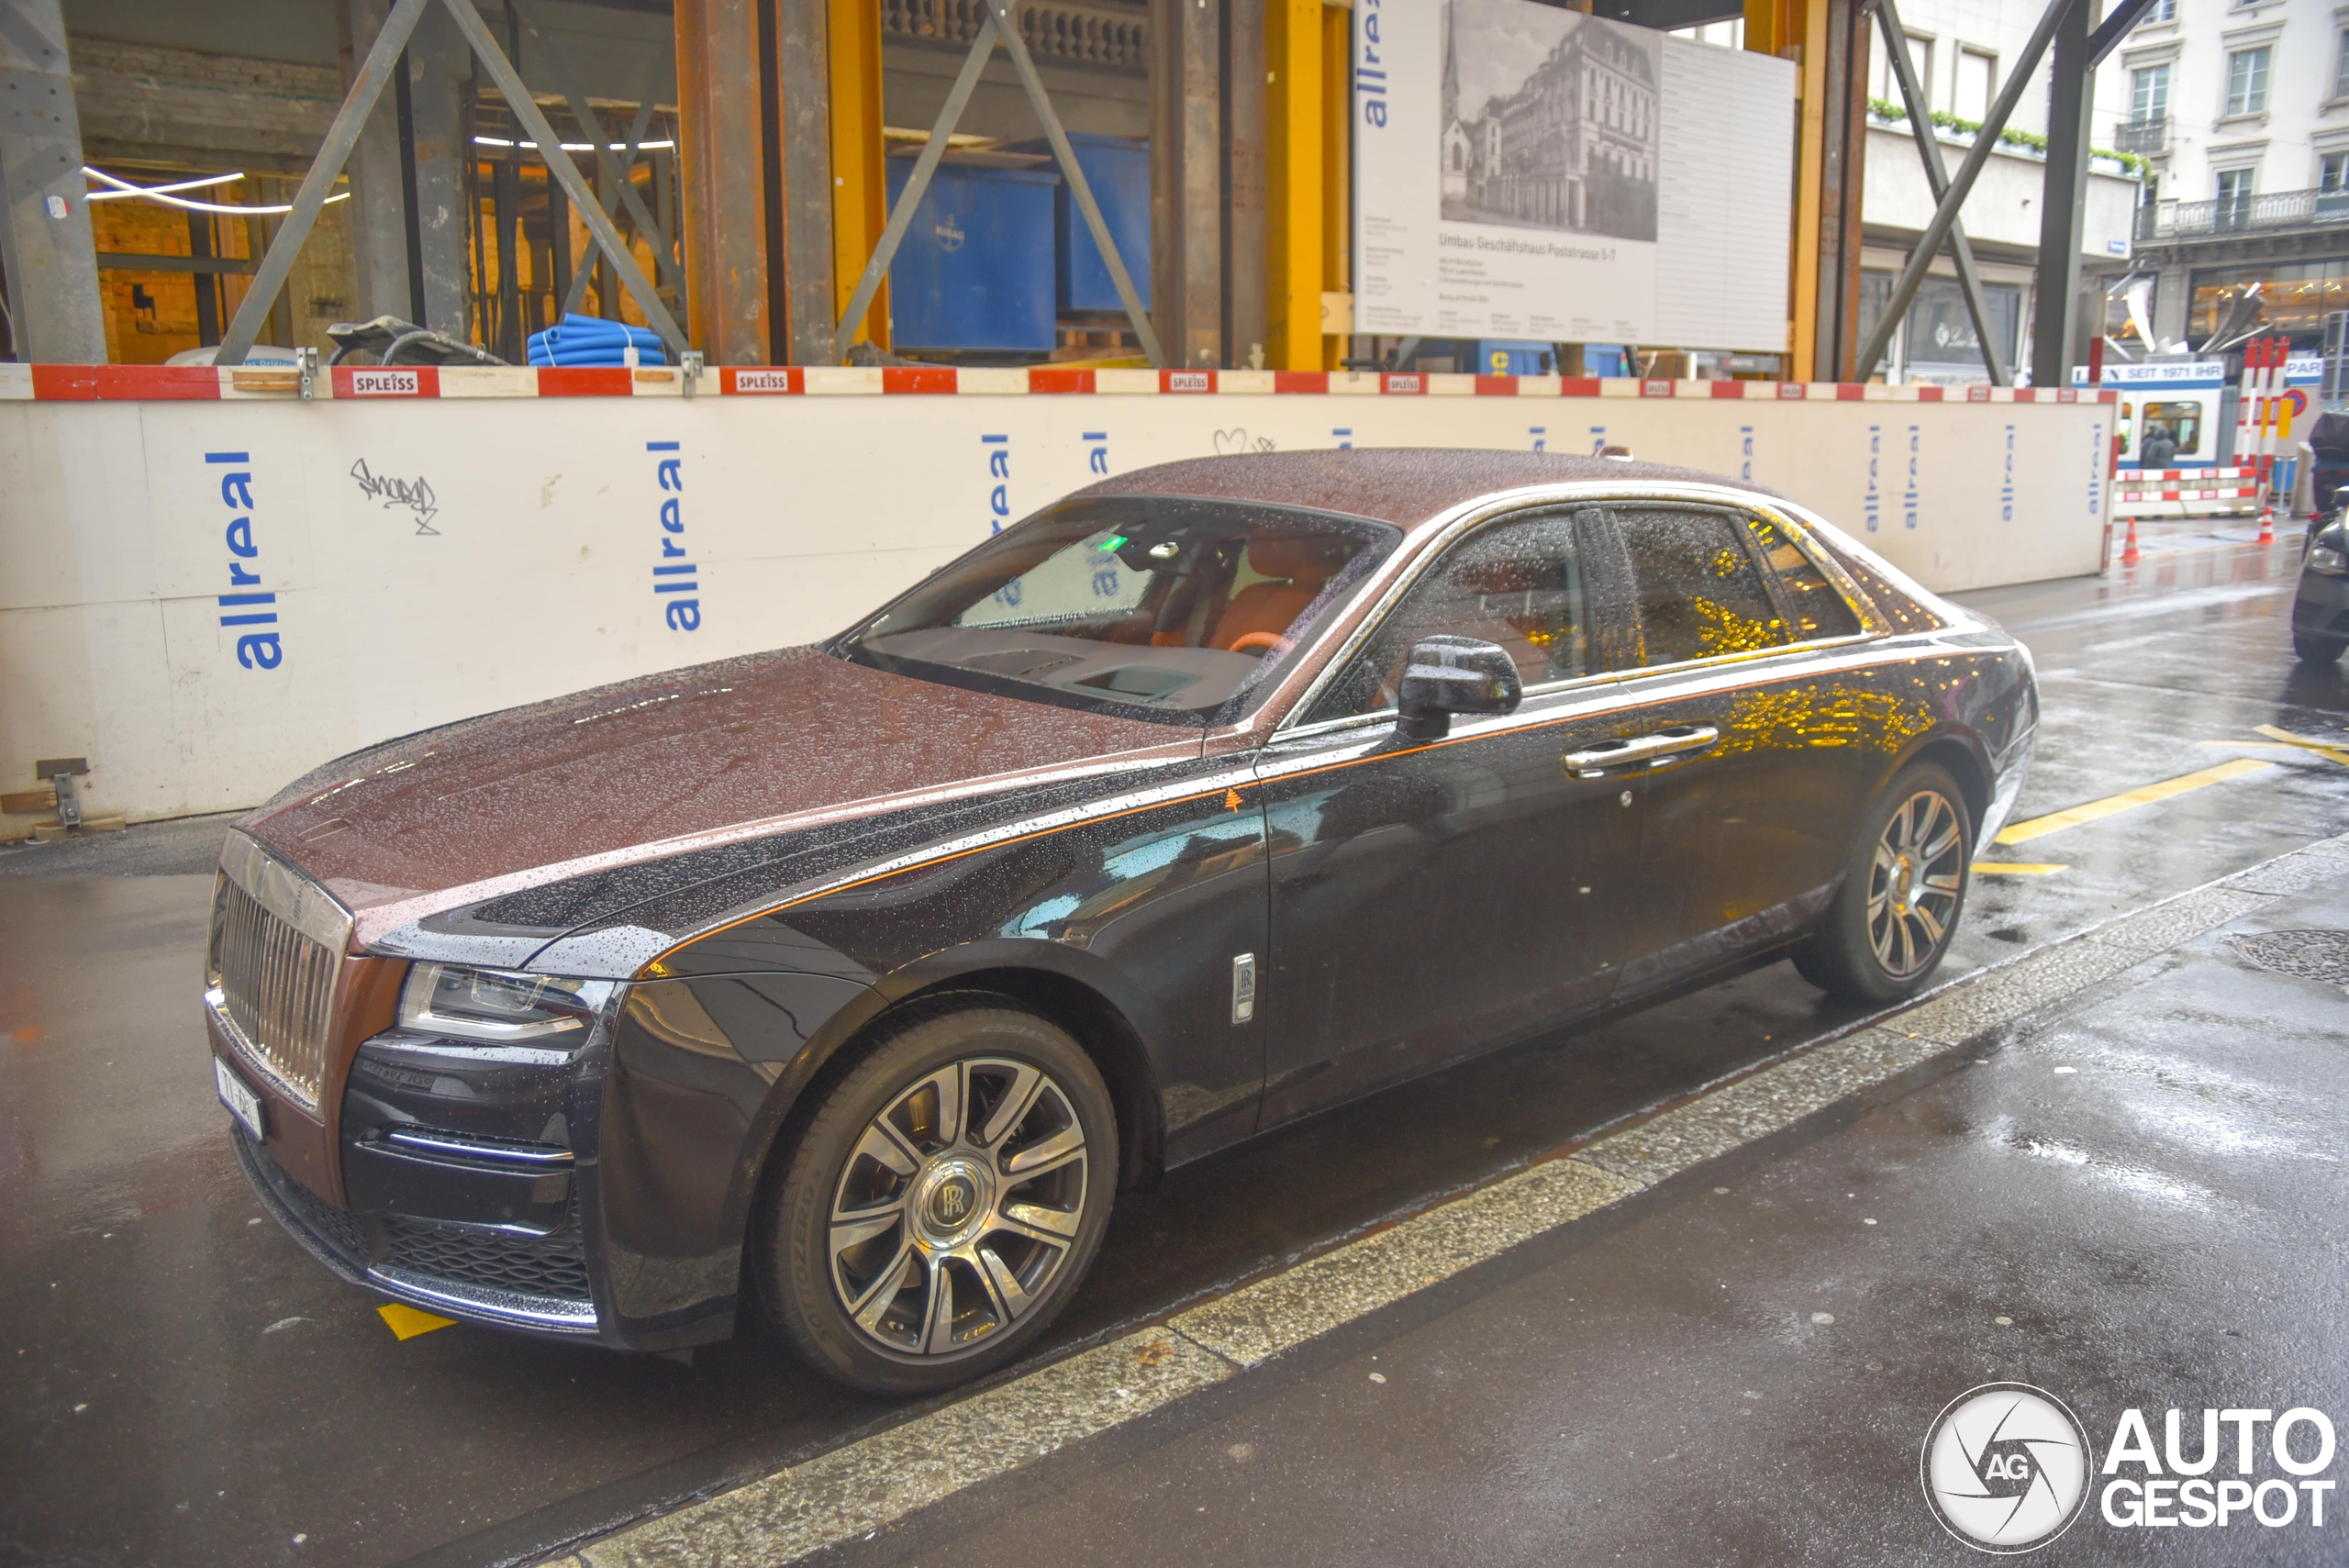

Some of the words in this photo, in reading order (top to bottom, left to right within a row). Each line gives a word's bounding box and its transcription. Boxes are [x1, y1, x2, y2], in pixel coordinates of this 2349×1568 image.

[1440, 233, 1475, 248] Umbau
[1477, 236, 1546, 255] Geschäftshaus
[1548, 242, 1599, 260] Poststrasse
[2128, 368, 2156, 379] SEIT
[2163, 367, 2190, 378] 1971
[2196, 366, 2221, 377] IHR
[1865, 426, 1880, 532] allreal
[1904, 426, 1919, 529] allreal
[2001, 425, 2015, 521] allreal
[2087, 424, 2101, 515] allreal
[205, 451, 283, 670] allreal
[646, 441, 700, 631] allreal
[942, 1184, 964, 1218] RR
